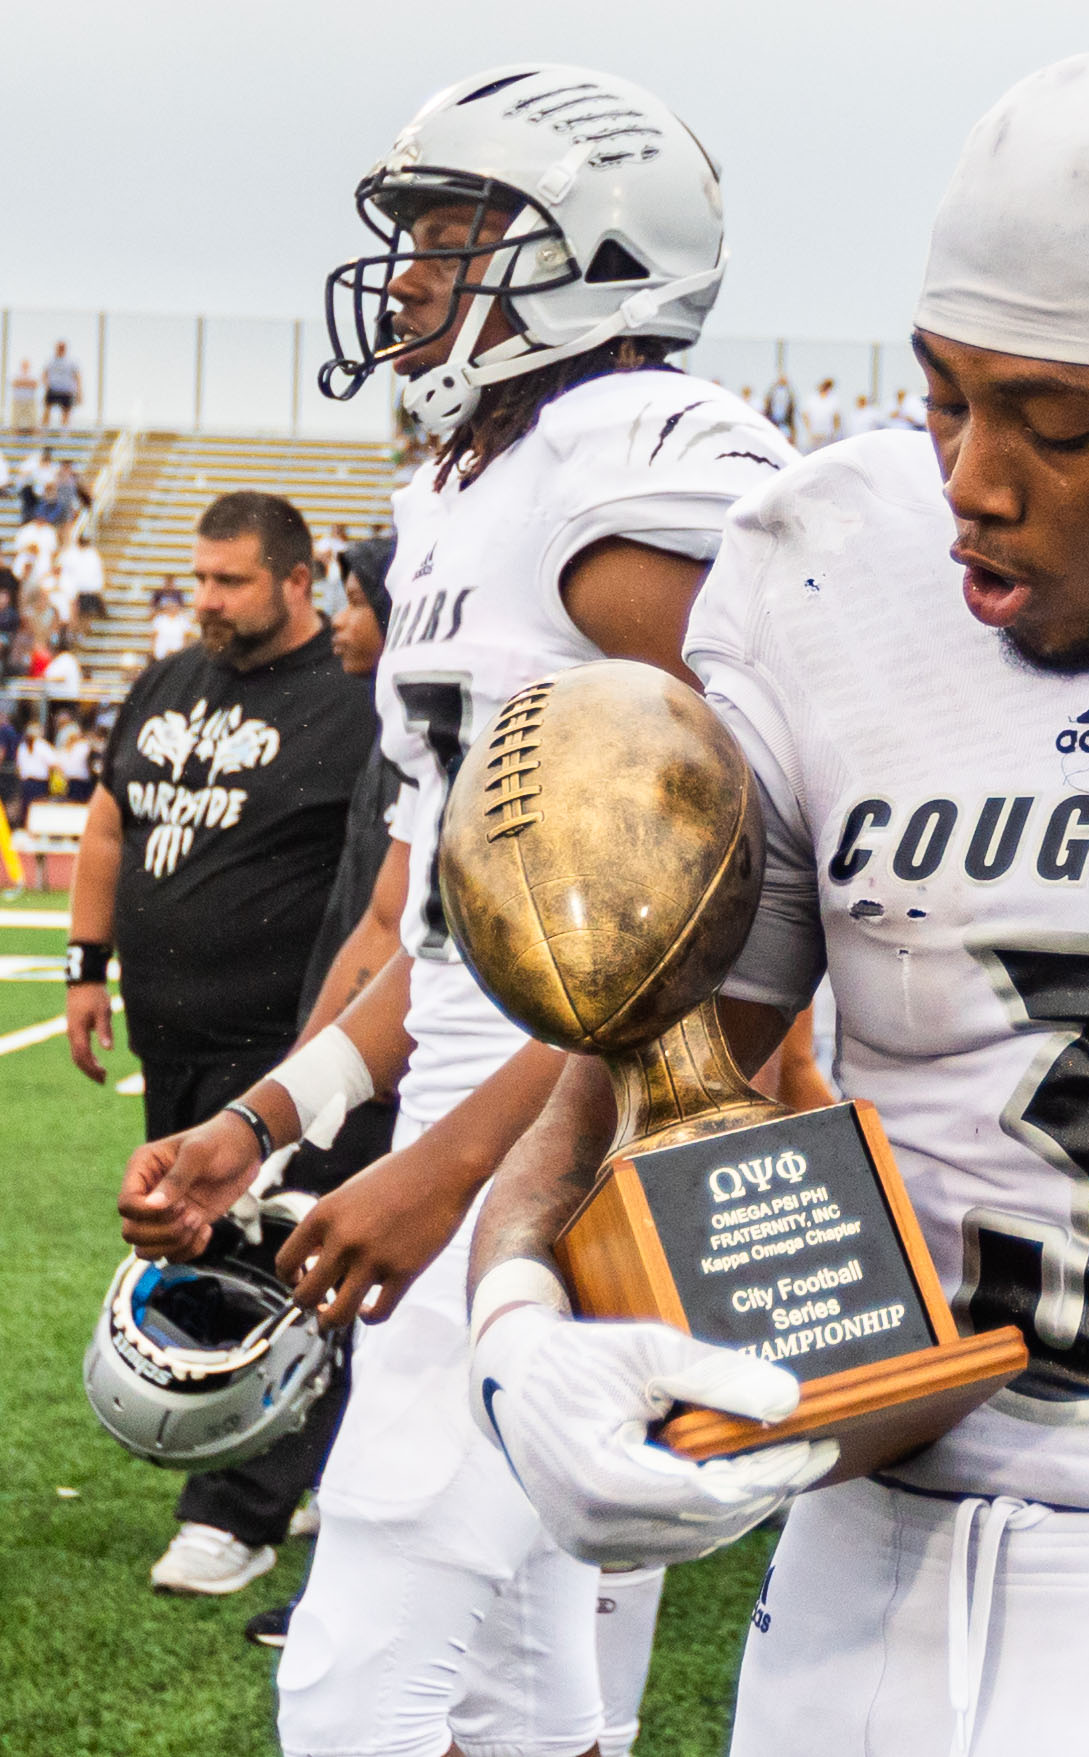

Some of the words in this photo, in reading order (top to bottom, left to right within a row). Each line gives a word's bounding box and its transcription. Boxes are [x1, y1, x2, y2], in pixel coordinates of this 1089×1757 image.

[709, 1151, 807, 1203] ΩΨΦ
[710, 1212, 812, 1250] FRATERNITY,
[811, 1204, 841, 1224] INC
[711, 1203, 772, 1230] OMEGA
[772, 1195, 799, 1214] PSI
[800, 1187, 829, 1206] PHI
[701, 1252, 750, 1274] Kappa
[751, 1236, 804, 1260] Omega
[805, 1221, 861, 1246] Chapter
[732, 1287, 773, 1312] City
[777, 1259, 863, 1301] Football
[738, 1304, 905, 1362] HAMPIONHIP
[772, 1298, 841, 1330] Series
